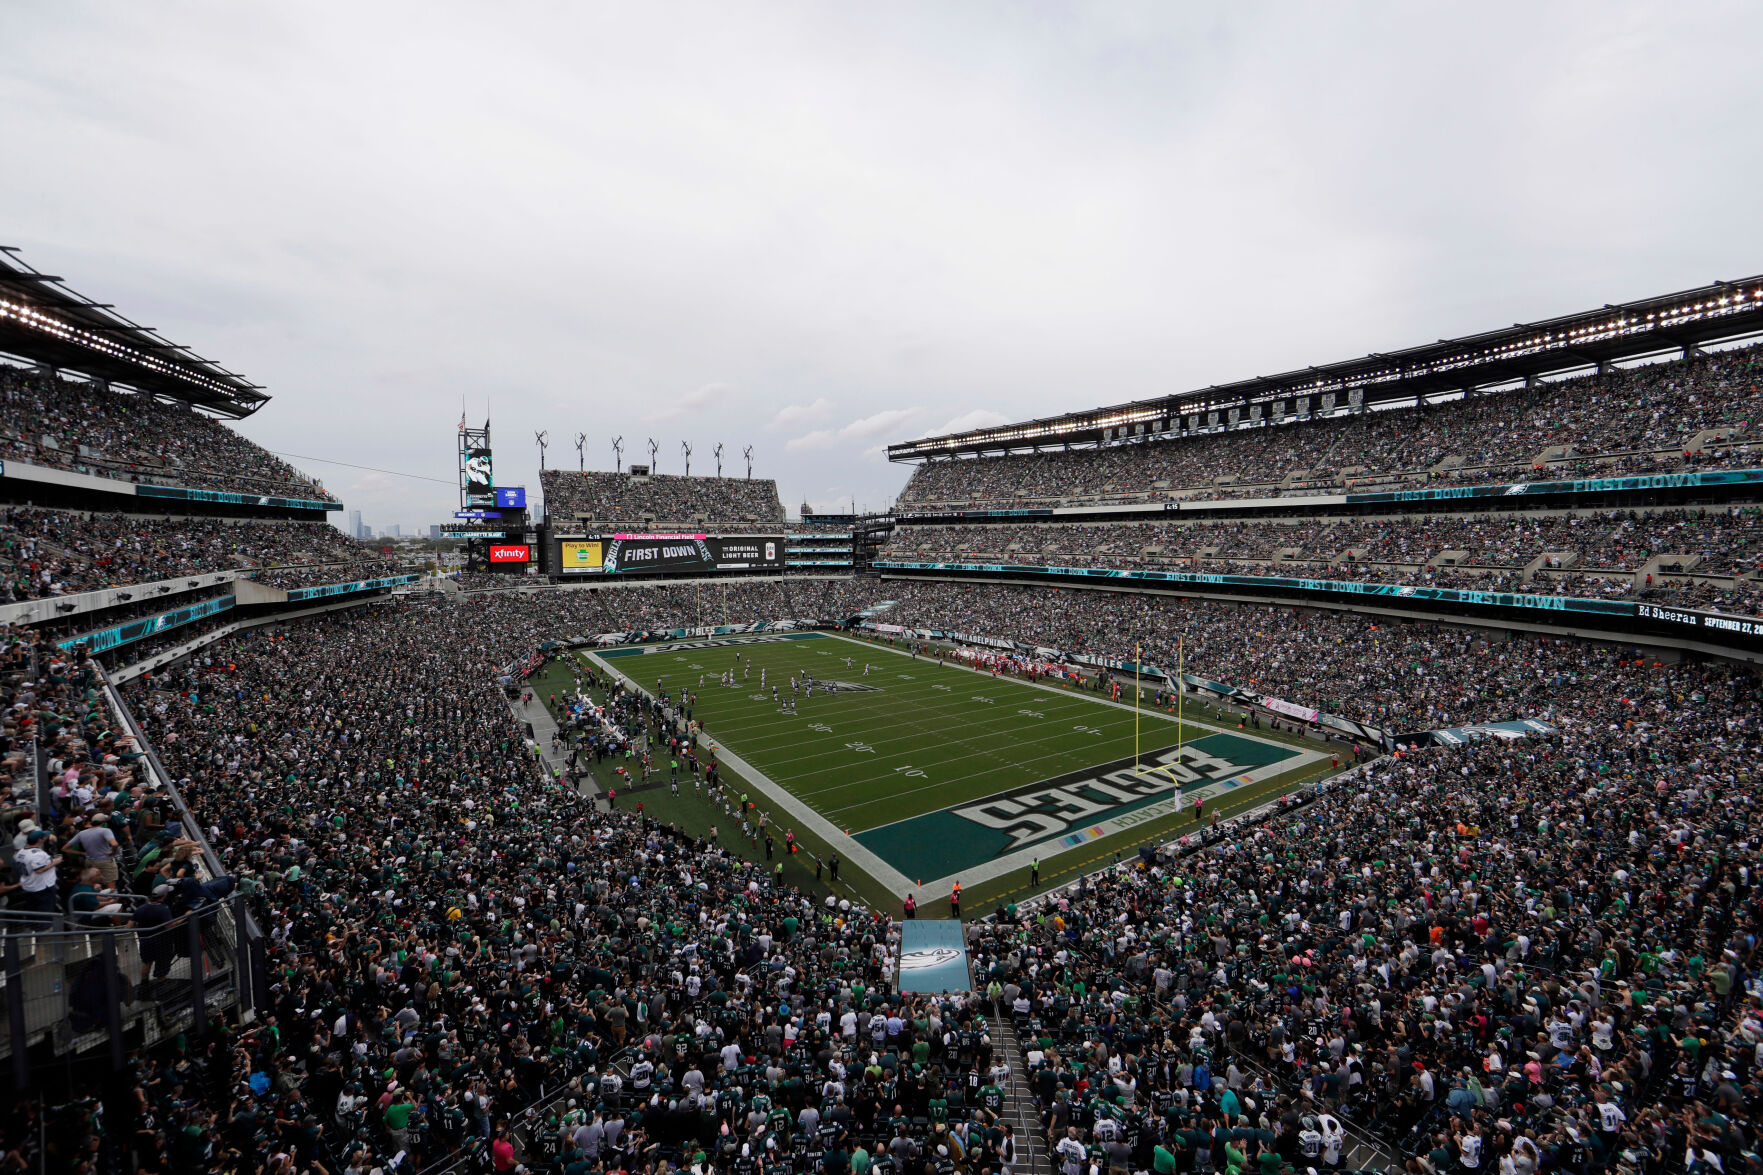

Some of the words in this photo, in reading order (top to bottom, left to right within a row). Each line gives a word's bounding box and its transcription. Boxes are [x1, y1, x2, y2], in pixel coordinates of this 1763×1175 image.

[1573, 479, 1622, 492] FIRST
[1639, 474, 1700, 489] DOWN
[187, 489, 213, 502] FIRST
[218, 492, 243, 504] DOWN
[1394, 491, 1427, 501] FIRST
[1434, 488, 1474, 499] DOWN
[494, 549, 526, 559] xfinity
[625, 547, 659, 562] FIRST
[663, 545, 697, 558] DOWN
[1167, 574, 1190, 582] FIRST
[1196, 575, 1223, 583] DOWN
[1299, 579, 1327, 590] FIRST
[1332, 582, 1364, 593] DOWN
[1459, 591, 1500, 605] FIRST
[1512, 594, 1566, 610] DOWN
[1638, 605, 1650, 617] Ed
[1652, 607, 1697, 625] Sheeran
[1704, 617, 1741, 631] SEPTEMBER
[1741, 622, 1753, 635] 27,
[95, 629, 121, 650] DOWN
[1084, 655, 1123, 670] EAGLES
[844, 741, 873, 753] 20
[893, 765, 924, 778] 10
[951, 745, 1260, 854] EAGLES
[1110, 806, 1163, 828] CATCH
[978, 973, 985, 981] 11
[874, 1022, 885, 1032] 54
[1308, 1026, 1317, 1036] 20
[675, 1043, 688, 1053] 92
[636, 1070, 649, 1080] 20
[969, 1075, 978, 1087] 18
[603, 1083, 614, 1093] 20
[985, 1095, 1000, 1107] 92
[933, 1107, 943, 1118] 17
[1072, 1112, 1081, 1120] 11
[443, 1119, 454, 1130] 11
[774, 1120, 785, 1132] 12
[1605, 1115, 1617, 1126] 11
[1101, 1129, 1114, 1141] 12
[1128, 1135, 1138, 1148] 20
[543, 1142, 556, 1154] 24
[1305, 1142, 1318, 1154] 31
